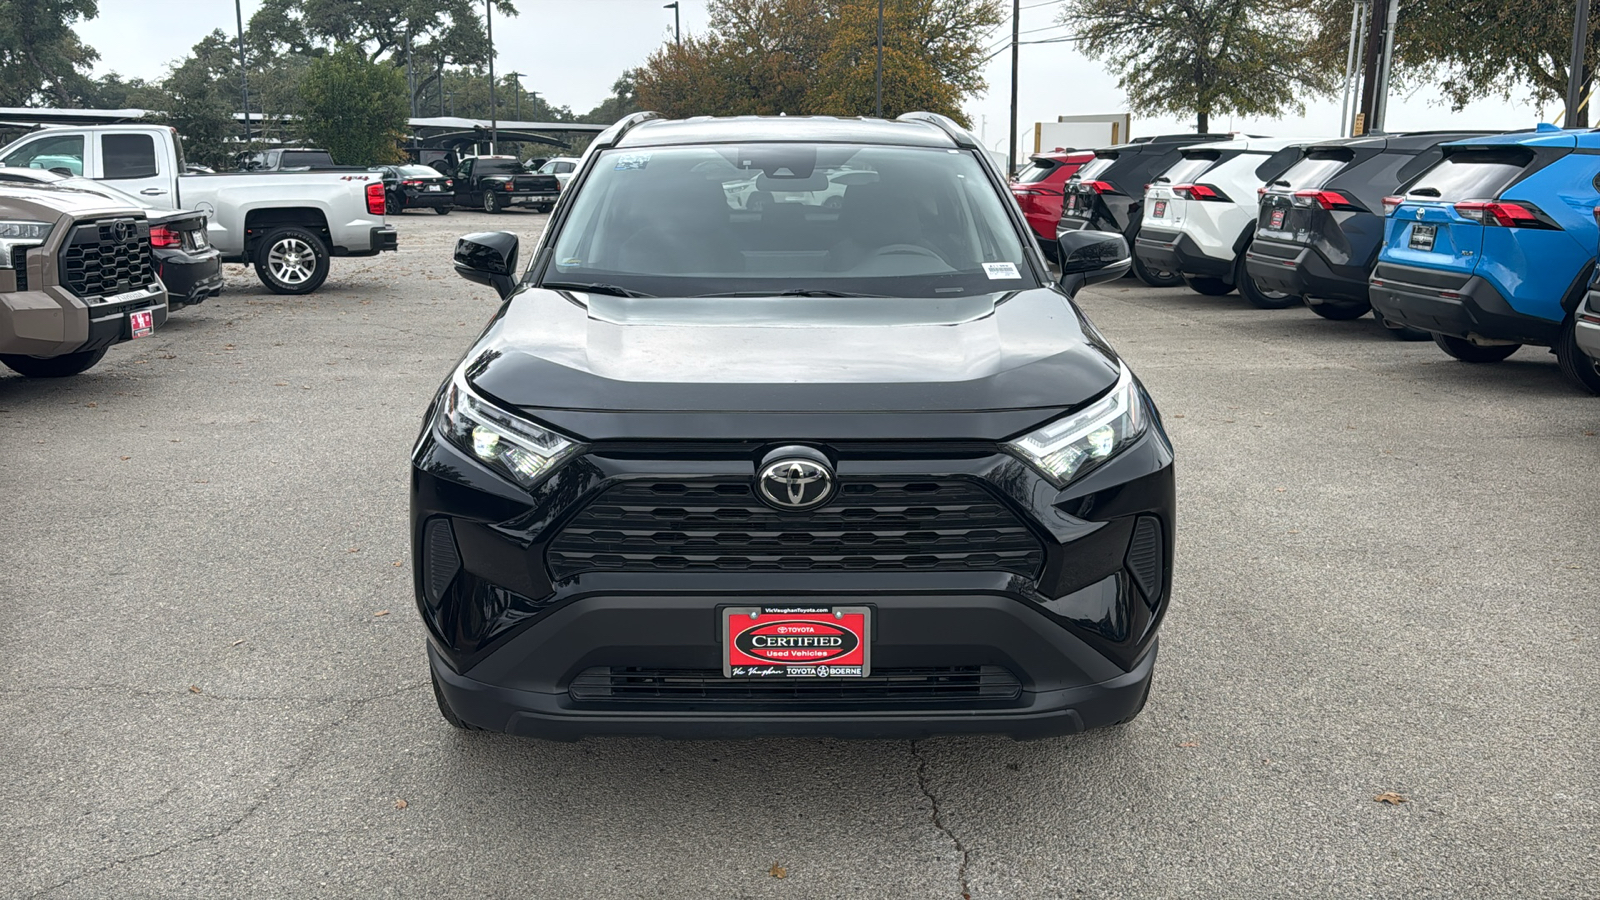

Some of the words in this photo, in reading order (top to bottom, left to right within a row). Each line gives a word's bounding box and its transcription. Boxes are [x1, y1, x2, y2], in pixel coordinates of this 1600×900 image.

[752, 635, 842, 647] CERTIFIED
[732, 667, 746, 676] Vic
[747, 666, 784, 677] Vaughan
